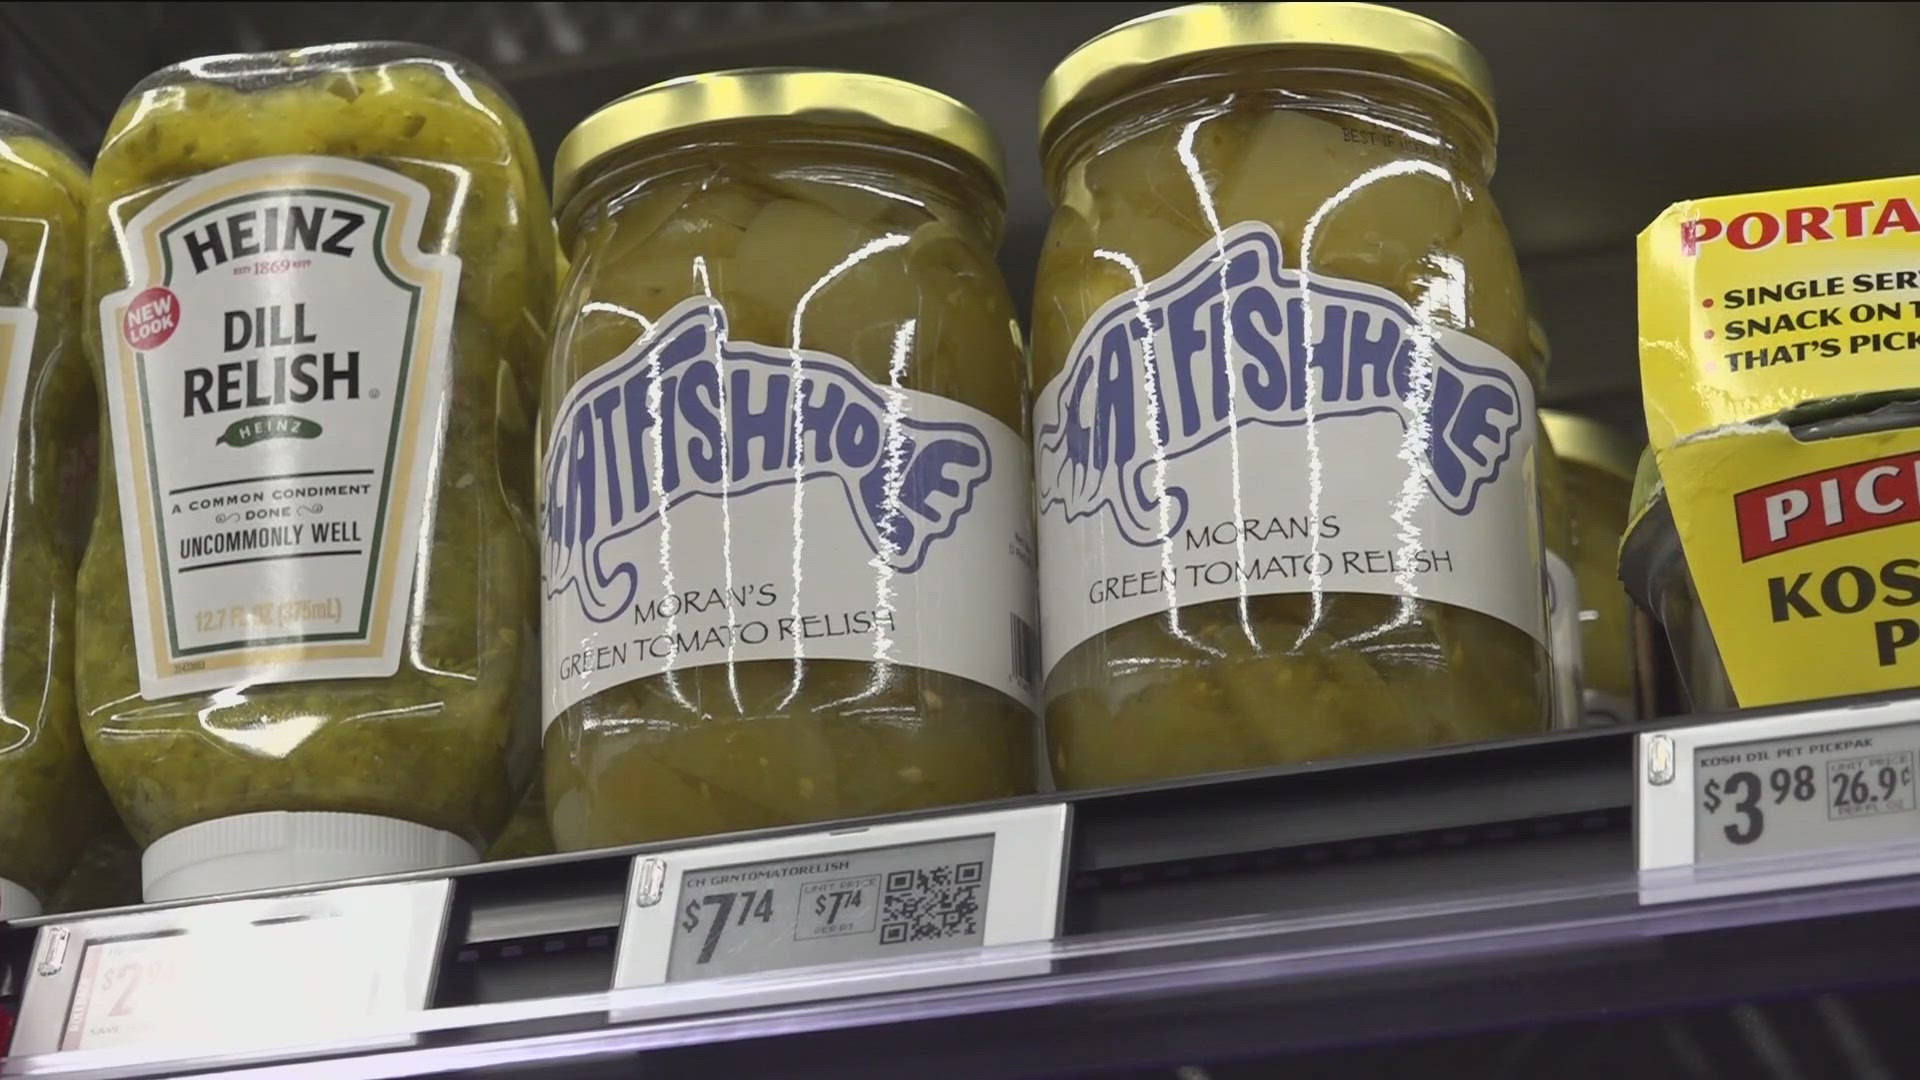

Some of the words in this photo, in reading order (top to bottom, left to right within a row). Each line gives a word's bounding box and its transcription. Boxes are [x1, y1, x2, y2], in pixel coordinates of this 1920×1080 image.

[1342, 128, 1375, 145] BEST
[183, 206, 365, 275] HEINZ
[254, 260, 290, 276] 1869
[1723, 277, 1844, 309] SINGLE
[1852, 271, 1920, 293] SER
[127, 297, 172, 328] NEW
[223, 303, 317, 353] DILL
[1724, 306, 1843, 341] SNACK
[1849, 302, 1901, 323] ON
[130, 318, 175, 344] LOOK
[1724, 338, 1841, 373] THAT'S
[183, 351, 361, 418] RELISH
[239, 415, 302, 440] HEINZ
[172, 504, 182, 515] A
[188, 491, 264, 511] COMMON
[272, 483, 372, 501] CONDIMENT
[245, 506, 291, 521] DONE
[1765, 459, 1920, 542] PIC
[180, 523, 304, 560] UNCOMMONLY
[311, 521, 362, 543] WELL
[1089, 567, 1177, 604] GREEN
[1185, 552, 1333, 587] TOMATO
[195, 610, 226, 633] 12.7
[634, 583, 777, 625] MORAN'S
[560, 642, 627, 680] GREEN
[633, 621, 769, 661] TOMATO
[777, 610, 895, 641] RELISH
[1701, 754, 1741, 768] KOSH
[1746, 751, 1770, 764] DIL
[686, 877, 706, 889] CH
